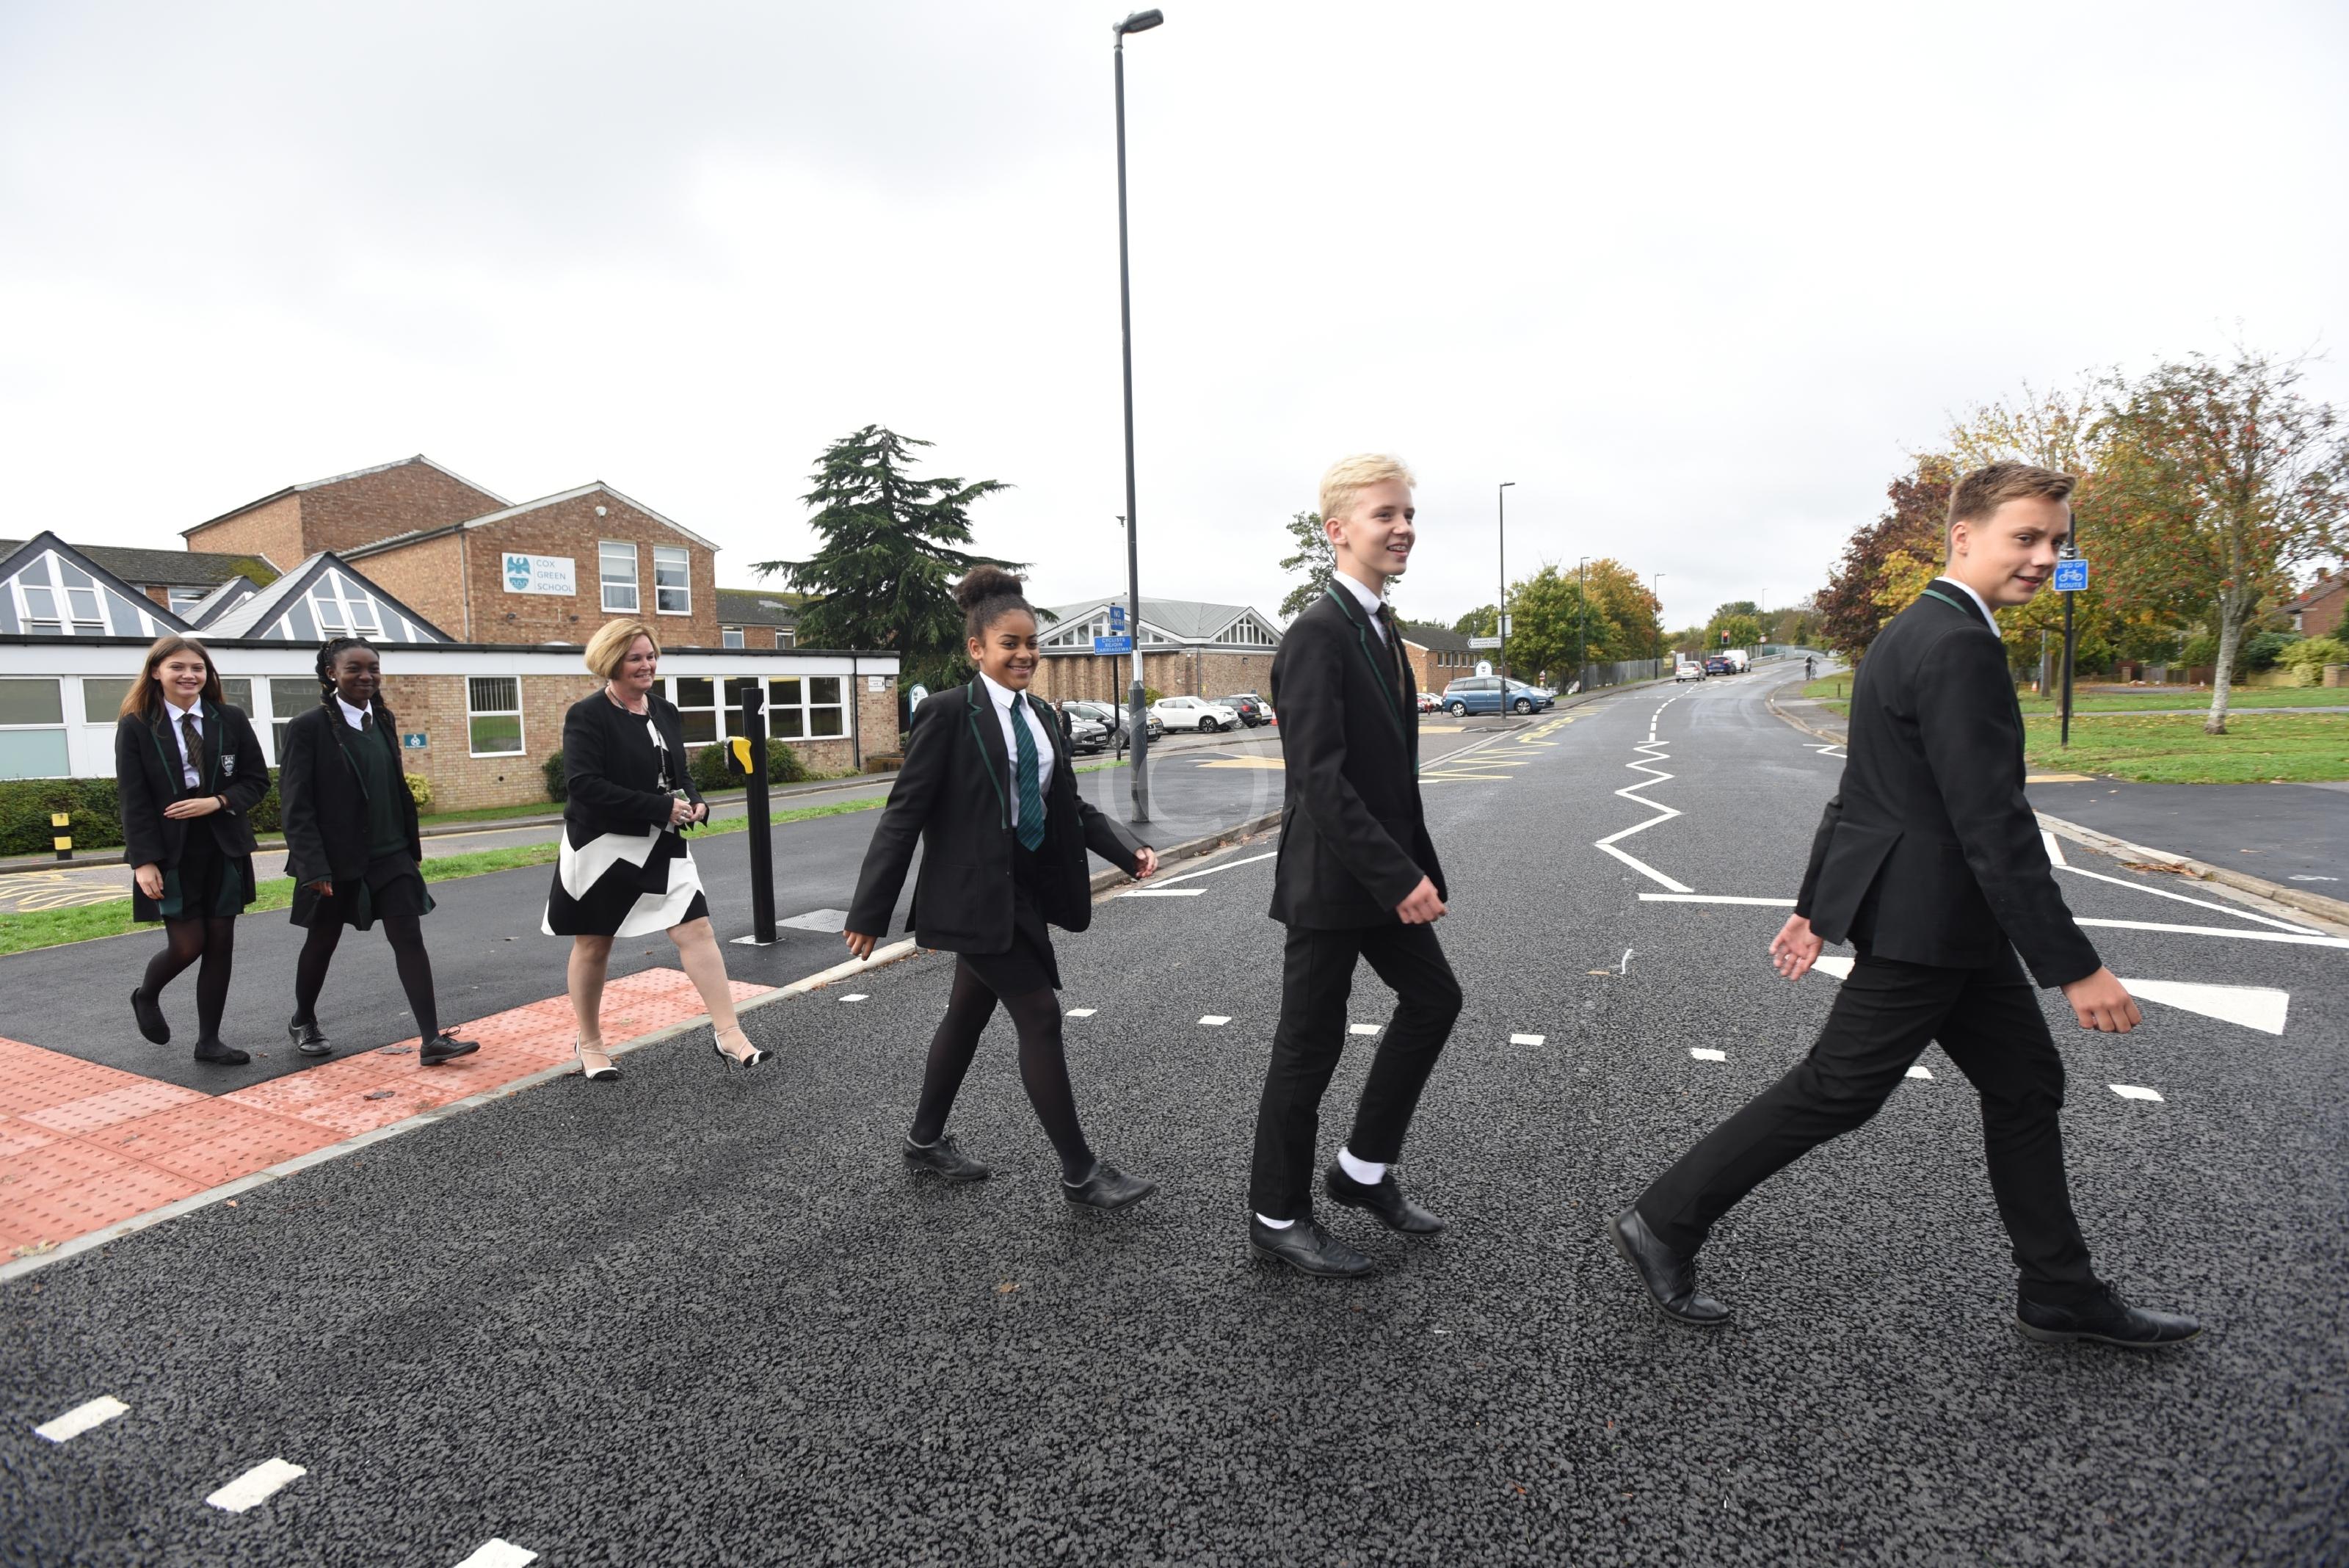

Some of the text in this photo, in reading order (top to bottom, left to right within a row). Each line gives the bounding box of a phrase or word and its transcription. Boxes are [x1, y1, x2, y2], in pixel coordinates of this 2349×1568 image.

[536, 559, 556, 567] COX
[537, 571, 566, 580] GREEN
[537, 583, 573, 592] SCHOOL
[1111, 618, 1125, 626] ENTRY
